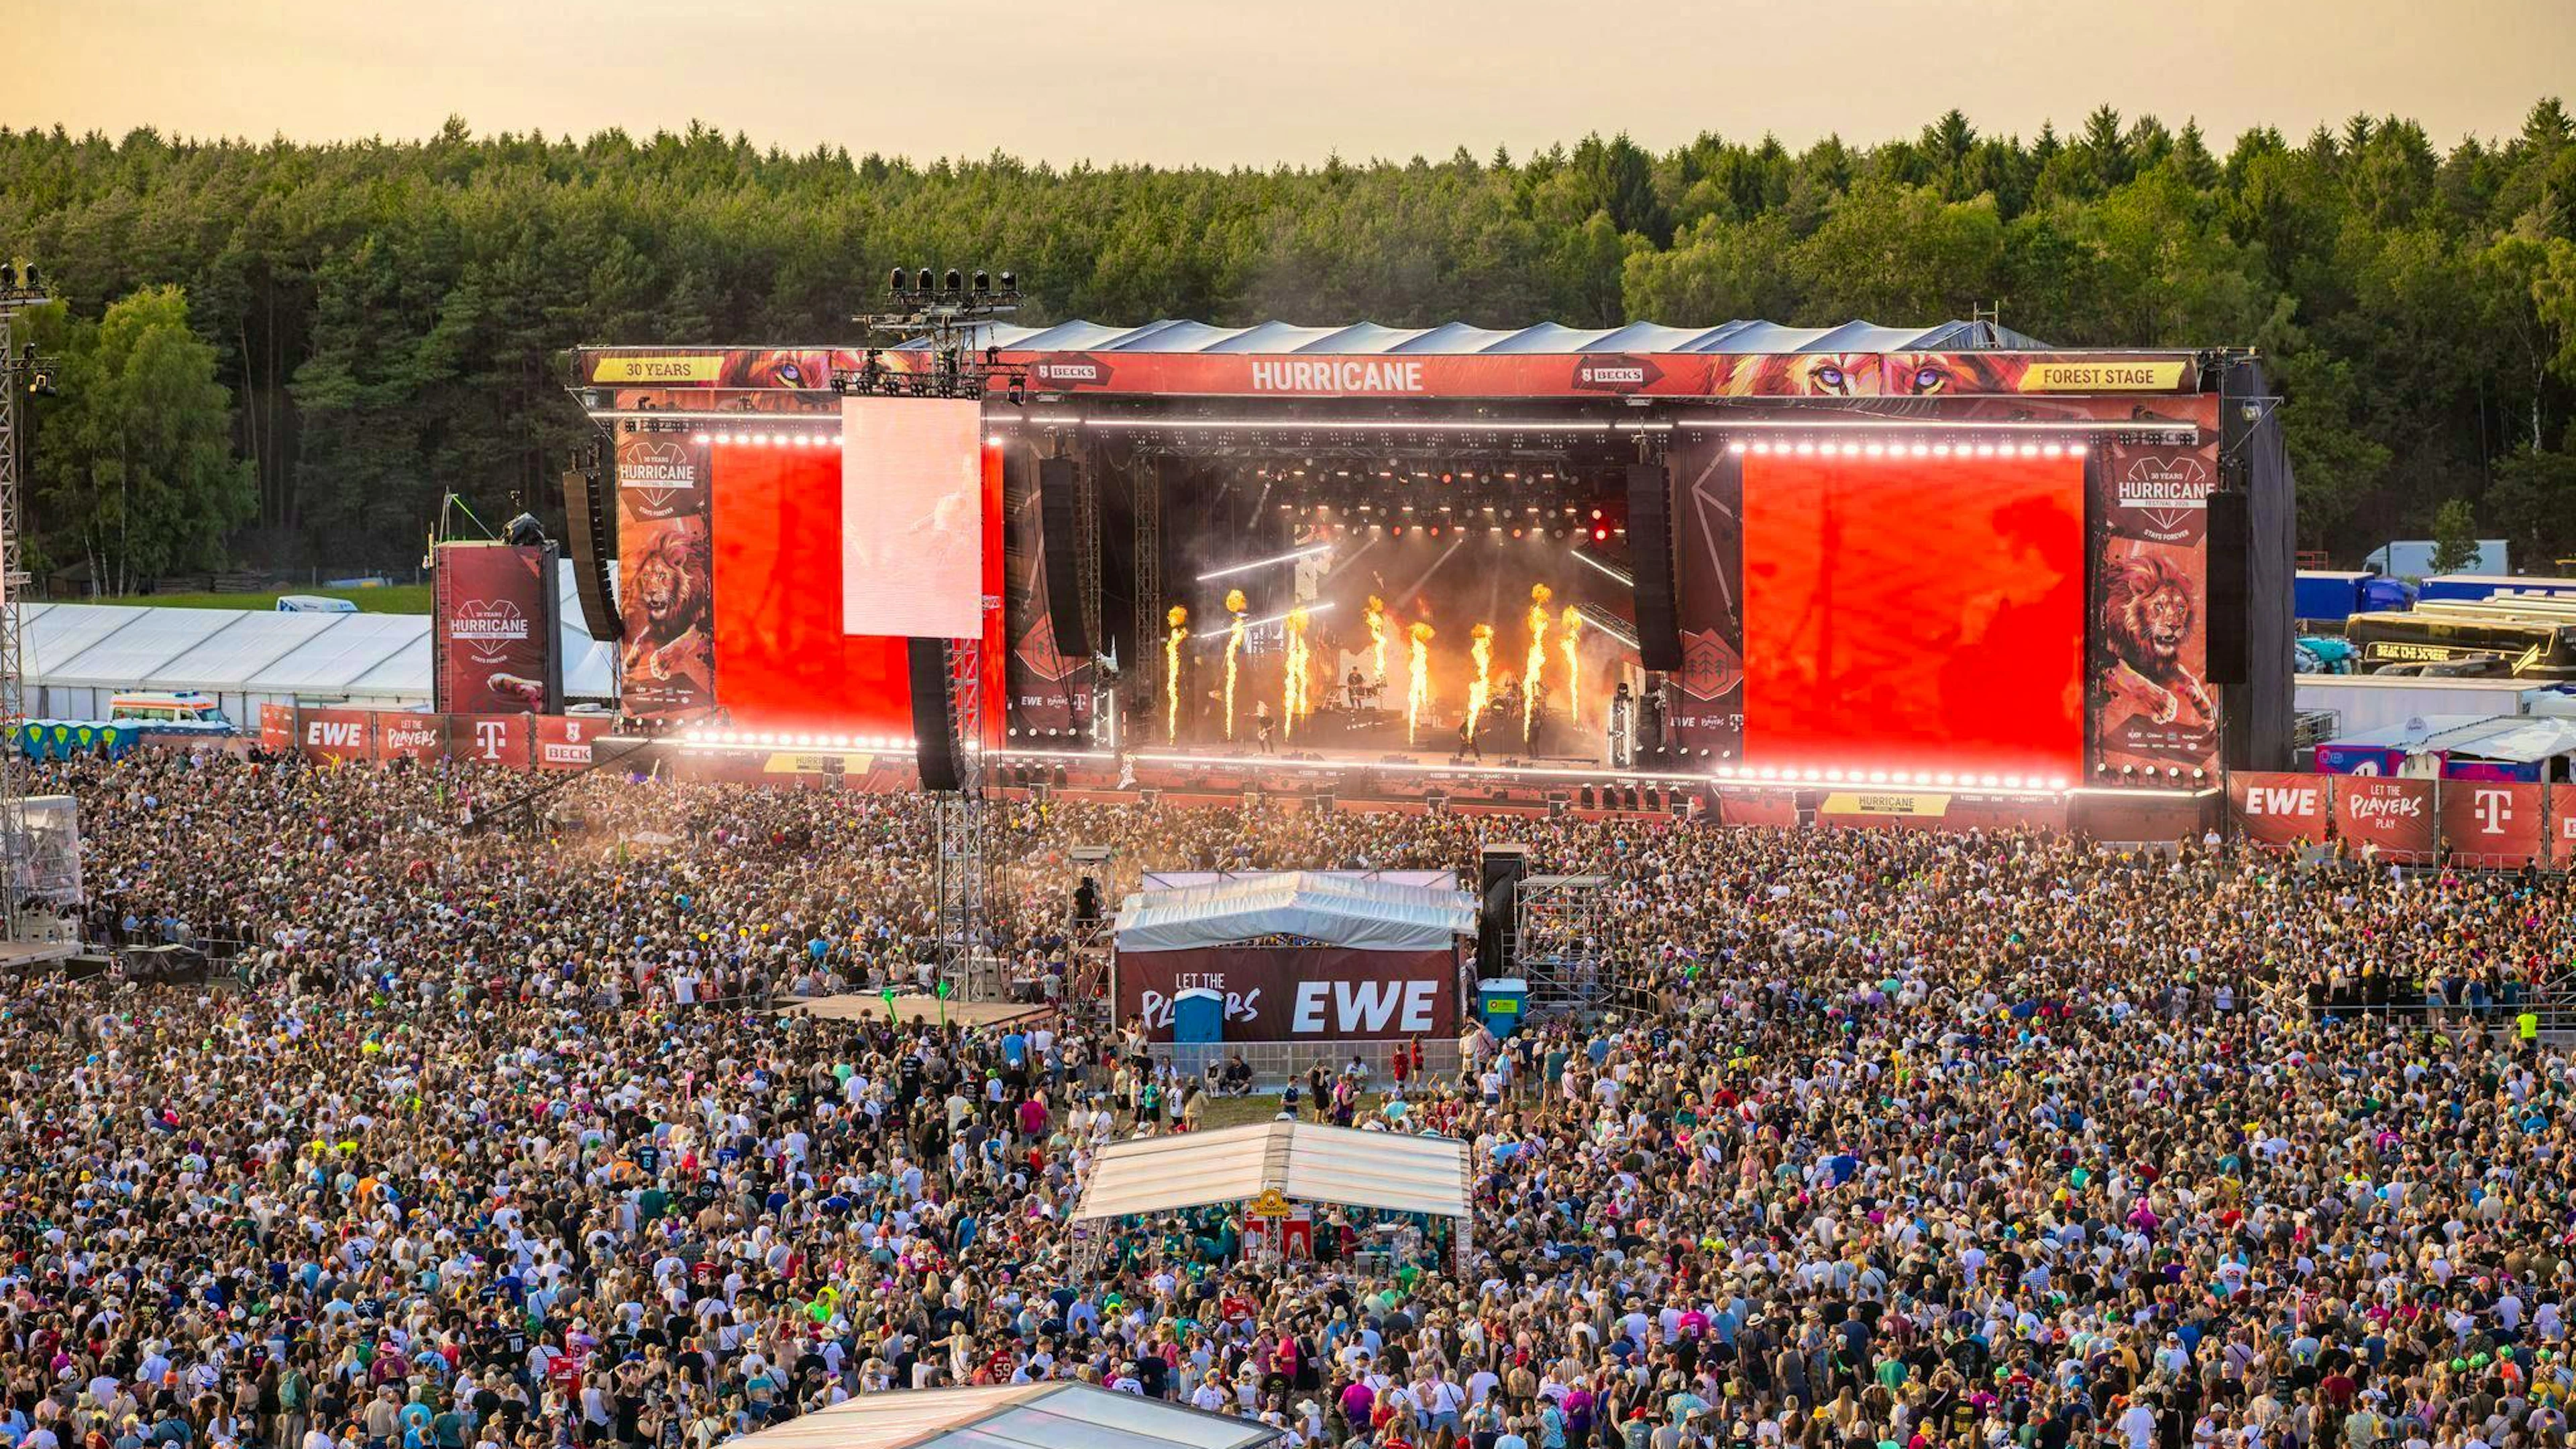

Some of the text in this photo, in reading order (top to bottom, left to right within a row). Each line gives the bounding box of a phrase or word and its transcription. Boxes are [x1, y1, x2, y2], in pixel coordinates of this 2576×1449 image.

[627, 364, 691, 376] 30 YEARS
[1252, 362, 1424, 392] HURRICANE
[2044, 370, 2154, 384] FOREST STAGE
[621, 465, 694, 480] HURRICANE
[2159, 472, 2184, 480] YEARS
[2143, 529, 2190, 541] STAYS FOREVER
[451, 619, 528, 632] HURRICANE
[1022, 696, 1042, 706] EWE
[307, 721, 362, 747] EWE
[388, 729, 437, 749] PLAYERS
[476, 722, 506, 759] T
[549, 747, 592, 759] BECK
[2371, 785, 2401, 796] LET THE
[1859, 796, 1915, 807] HURRICANE
[2245, 788, 2317, 816] EWE
[2350, 794, 2422, 819] PLAYERS
[2475, 790, 2512, 834] T
[2376, 818, 2396, 829] PLAY
[1175, 973, 1225, 989] LET THE
[1142, 987, 1260, 1031] PLRS
[1291, 981, 1439, 1032] EWE
[509, 1337, 523, 1353] 10
[994, 1362, 1011, 1378] 59
